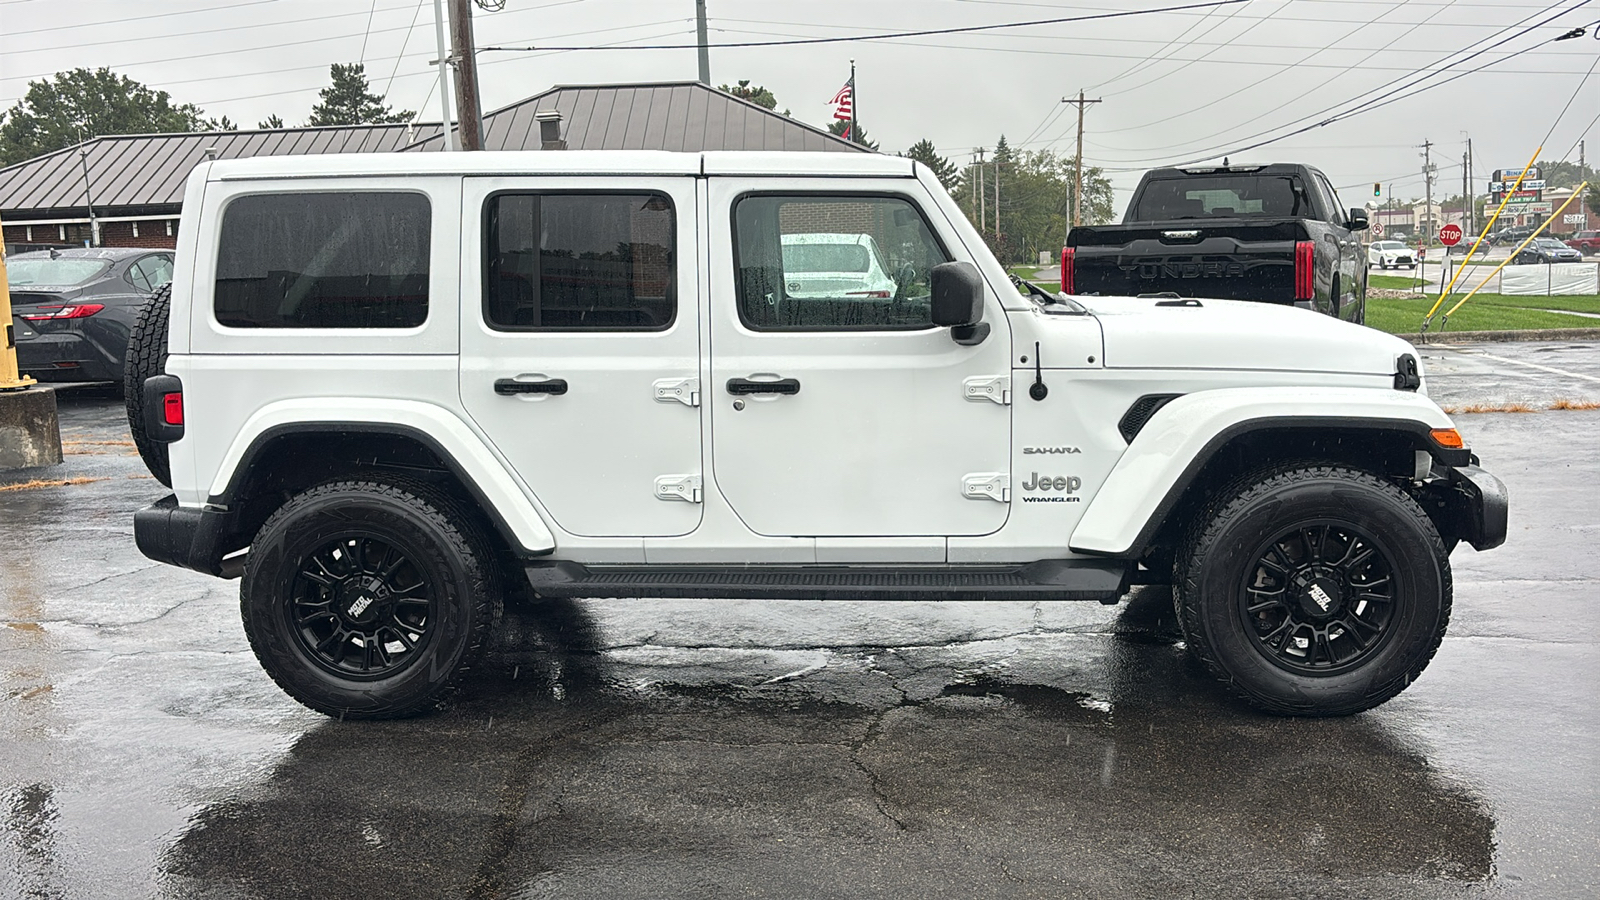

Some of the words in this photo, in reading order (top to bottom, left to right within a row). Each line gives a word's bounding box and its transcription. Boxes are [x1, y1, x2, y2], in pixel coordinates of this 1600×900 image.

[1440, 230, 1461, 240] STOP
[1118, 262, 1245, 280] TUNDRA
[1023, 447, 1082, 455] SAHARA
[1022, 471, 1081, 494] Jeep
[347, 595, 366, 616] MOTO
